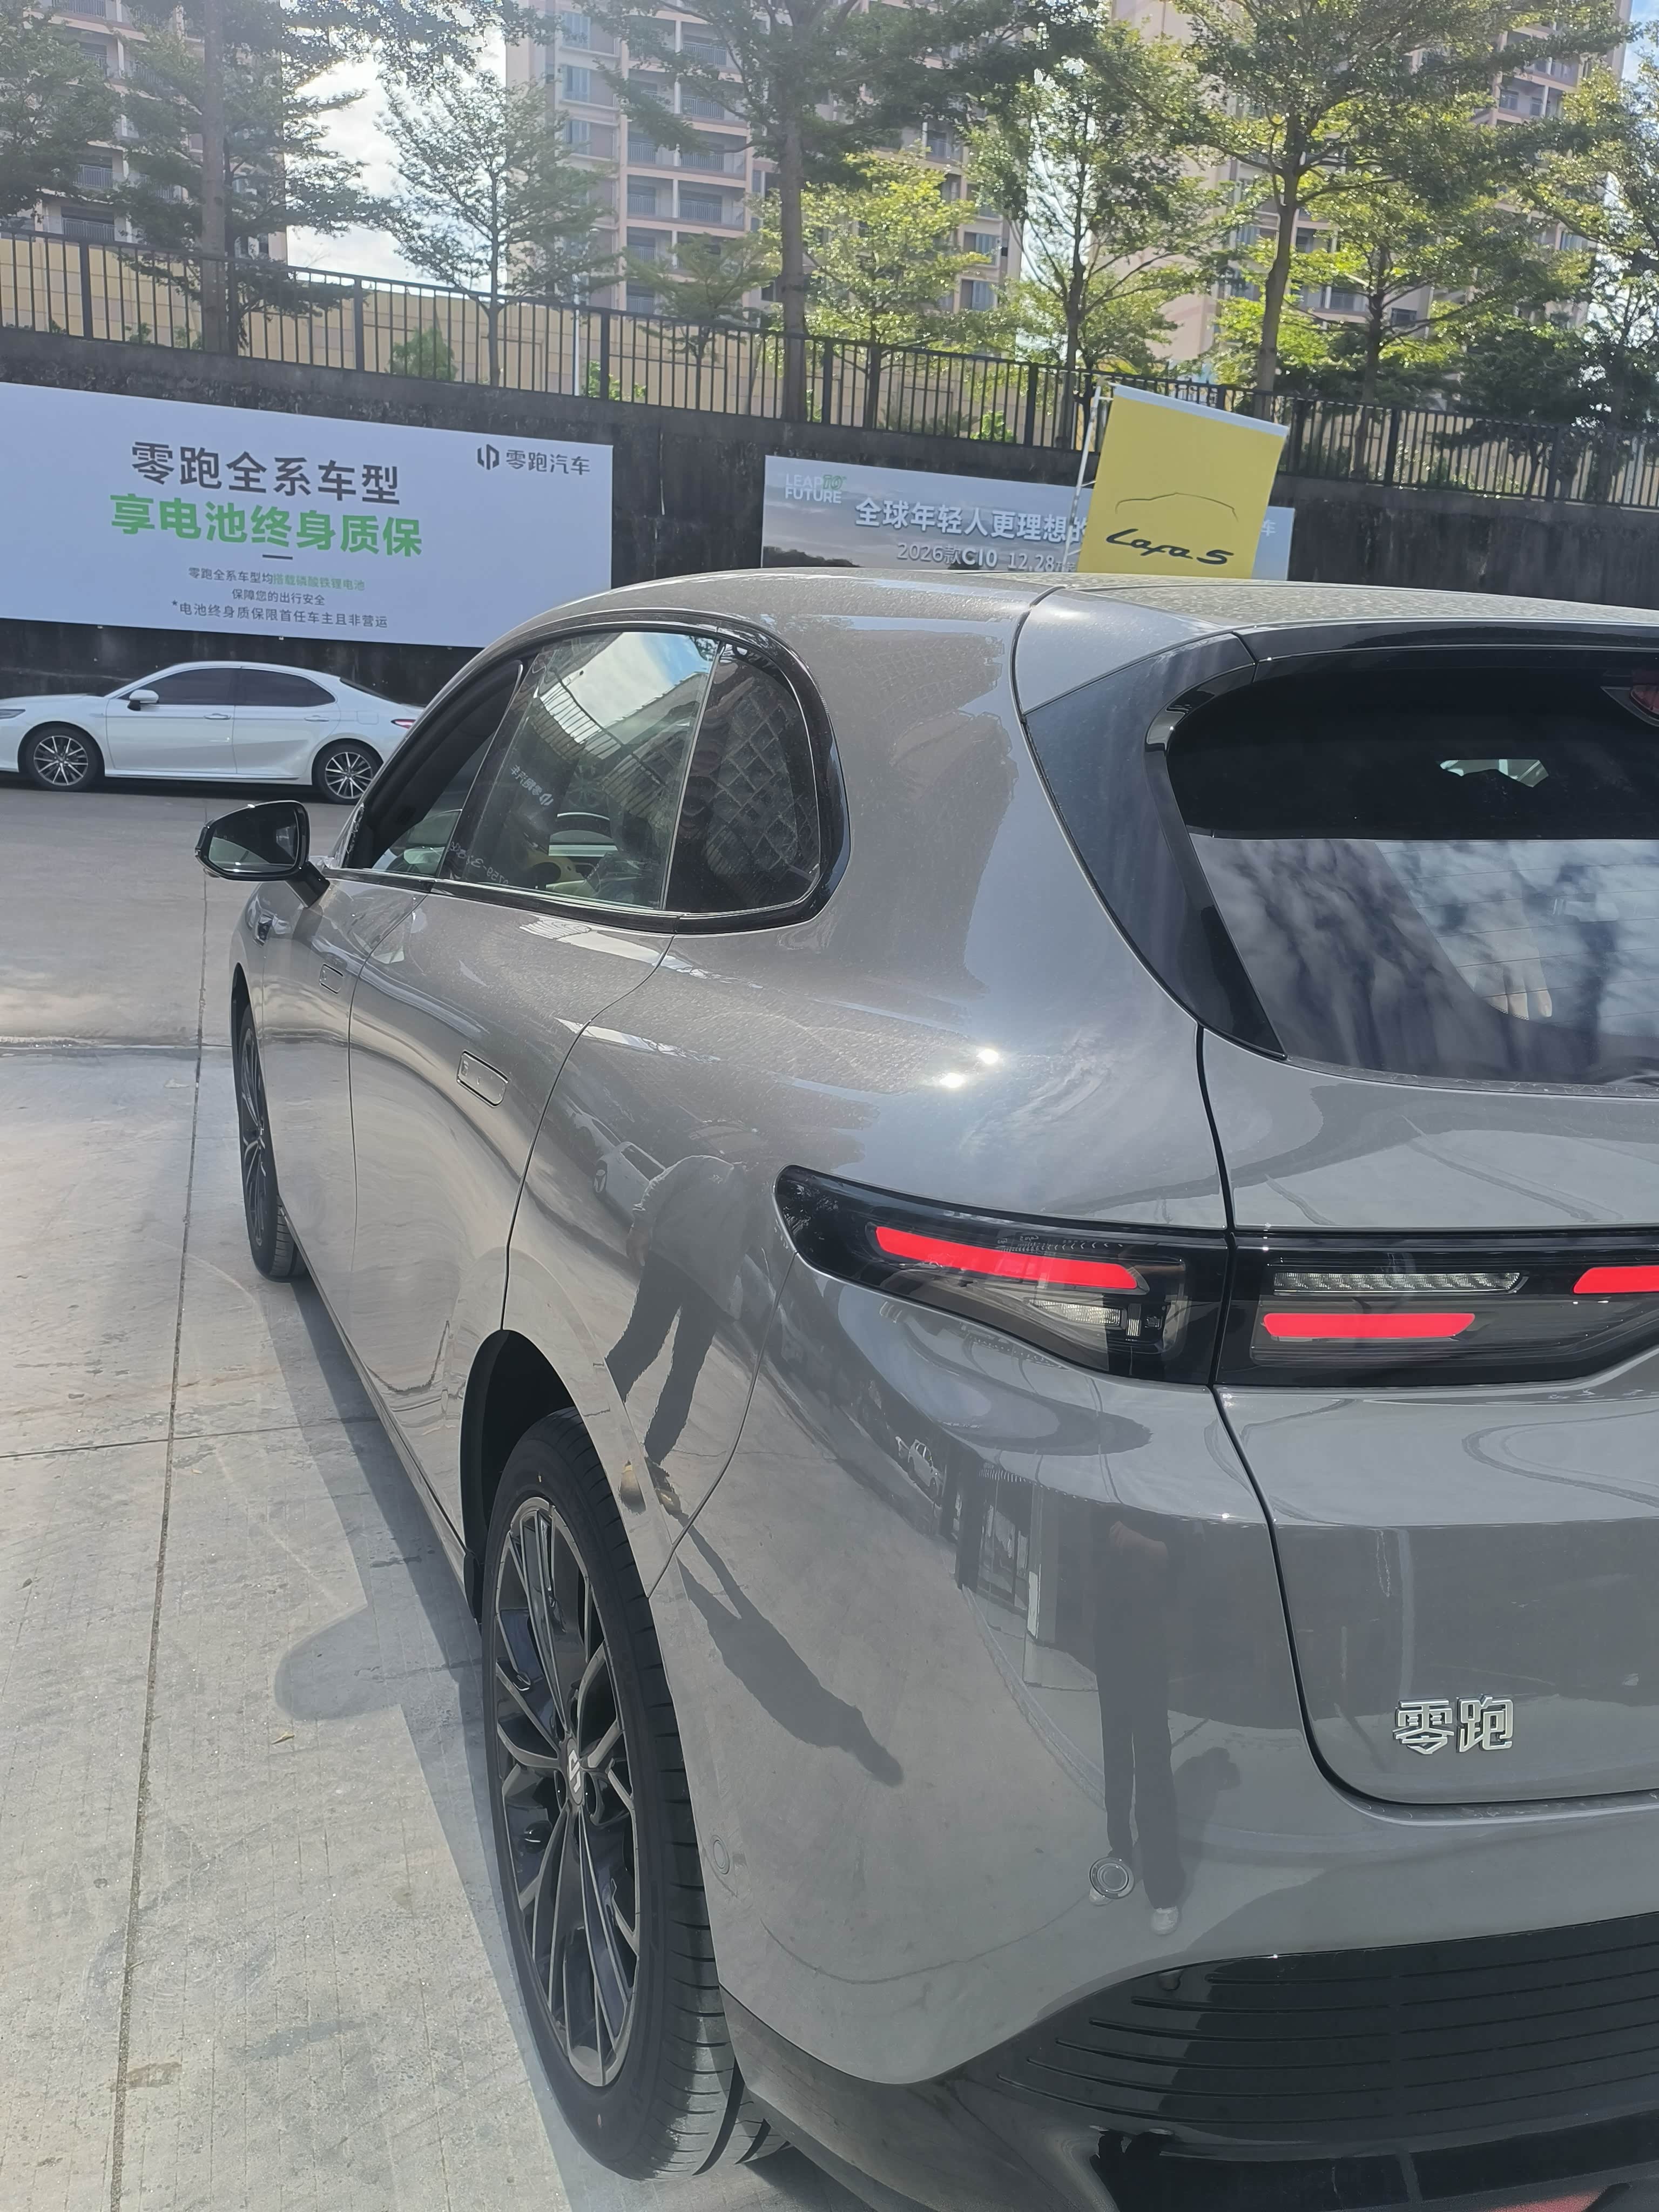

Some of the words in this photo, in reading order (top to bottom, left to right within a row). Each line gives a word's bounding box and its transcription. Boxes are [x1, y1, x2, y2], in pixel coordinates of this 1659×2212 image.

[131, 441, 400, 505] 零跑全系车型
[505, 449, 590, 475] 零跑汽车
[785, 487, 842, 504] FUTURE
[110, 493, 422, 557] 享电池终身质保
[232, 588, 326, 606] 保障您的出行安全
[1392, 1694, 1513, 1755] 零跑
